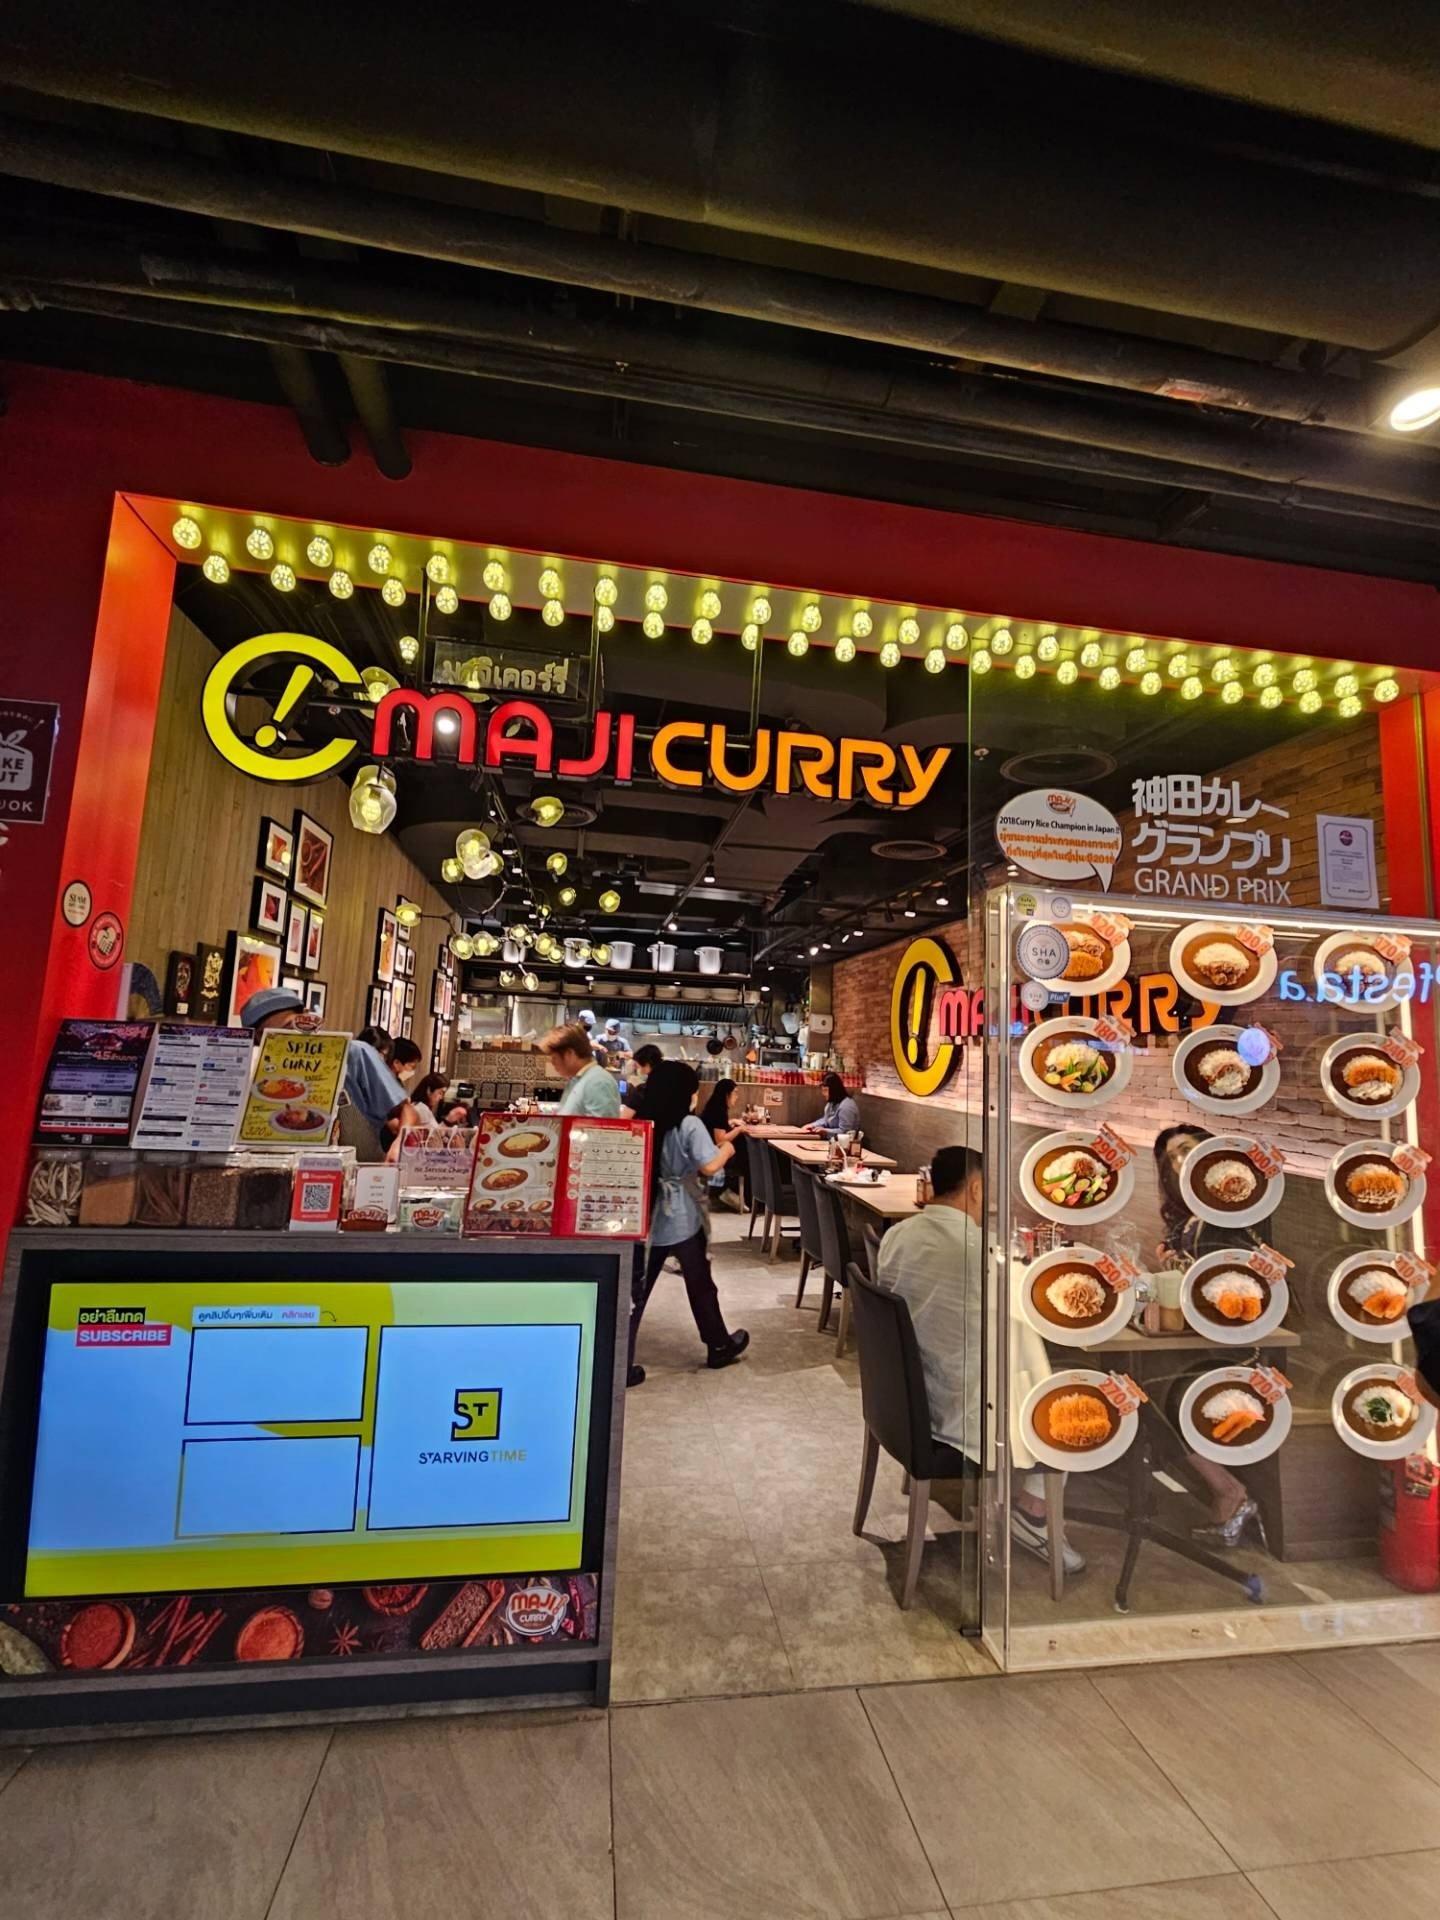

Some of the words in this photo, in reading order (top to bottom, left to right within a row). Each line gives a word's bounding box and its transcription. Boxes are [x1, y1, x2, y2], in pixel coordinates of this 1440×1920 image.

[372, 688, 635, 782] MAJI
[651, 720, 952, 808] CURRY
[1131, 773, 1290, 819] 神田カレー
[1035, 818, 1050, 828] Rice
[1050, 820, 1086, 833] Champion
[1087, 824, 1094, 832] in
[1095, 824, 1115, 835] Japan
[1131, 819, 1291, 875] グランプリ
[1134, 868, 1230, 900] GRAND
[1236, 876, 1292, 905] PRIX
[1032, 947, 1056, 957] SHA
[79, 1309, 144, 1324] อย่าลืมกด
[79, 1328, 168, 1343] SUBSCRIBE
